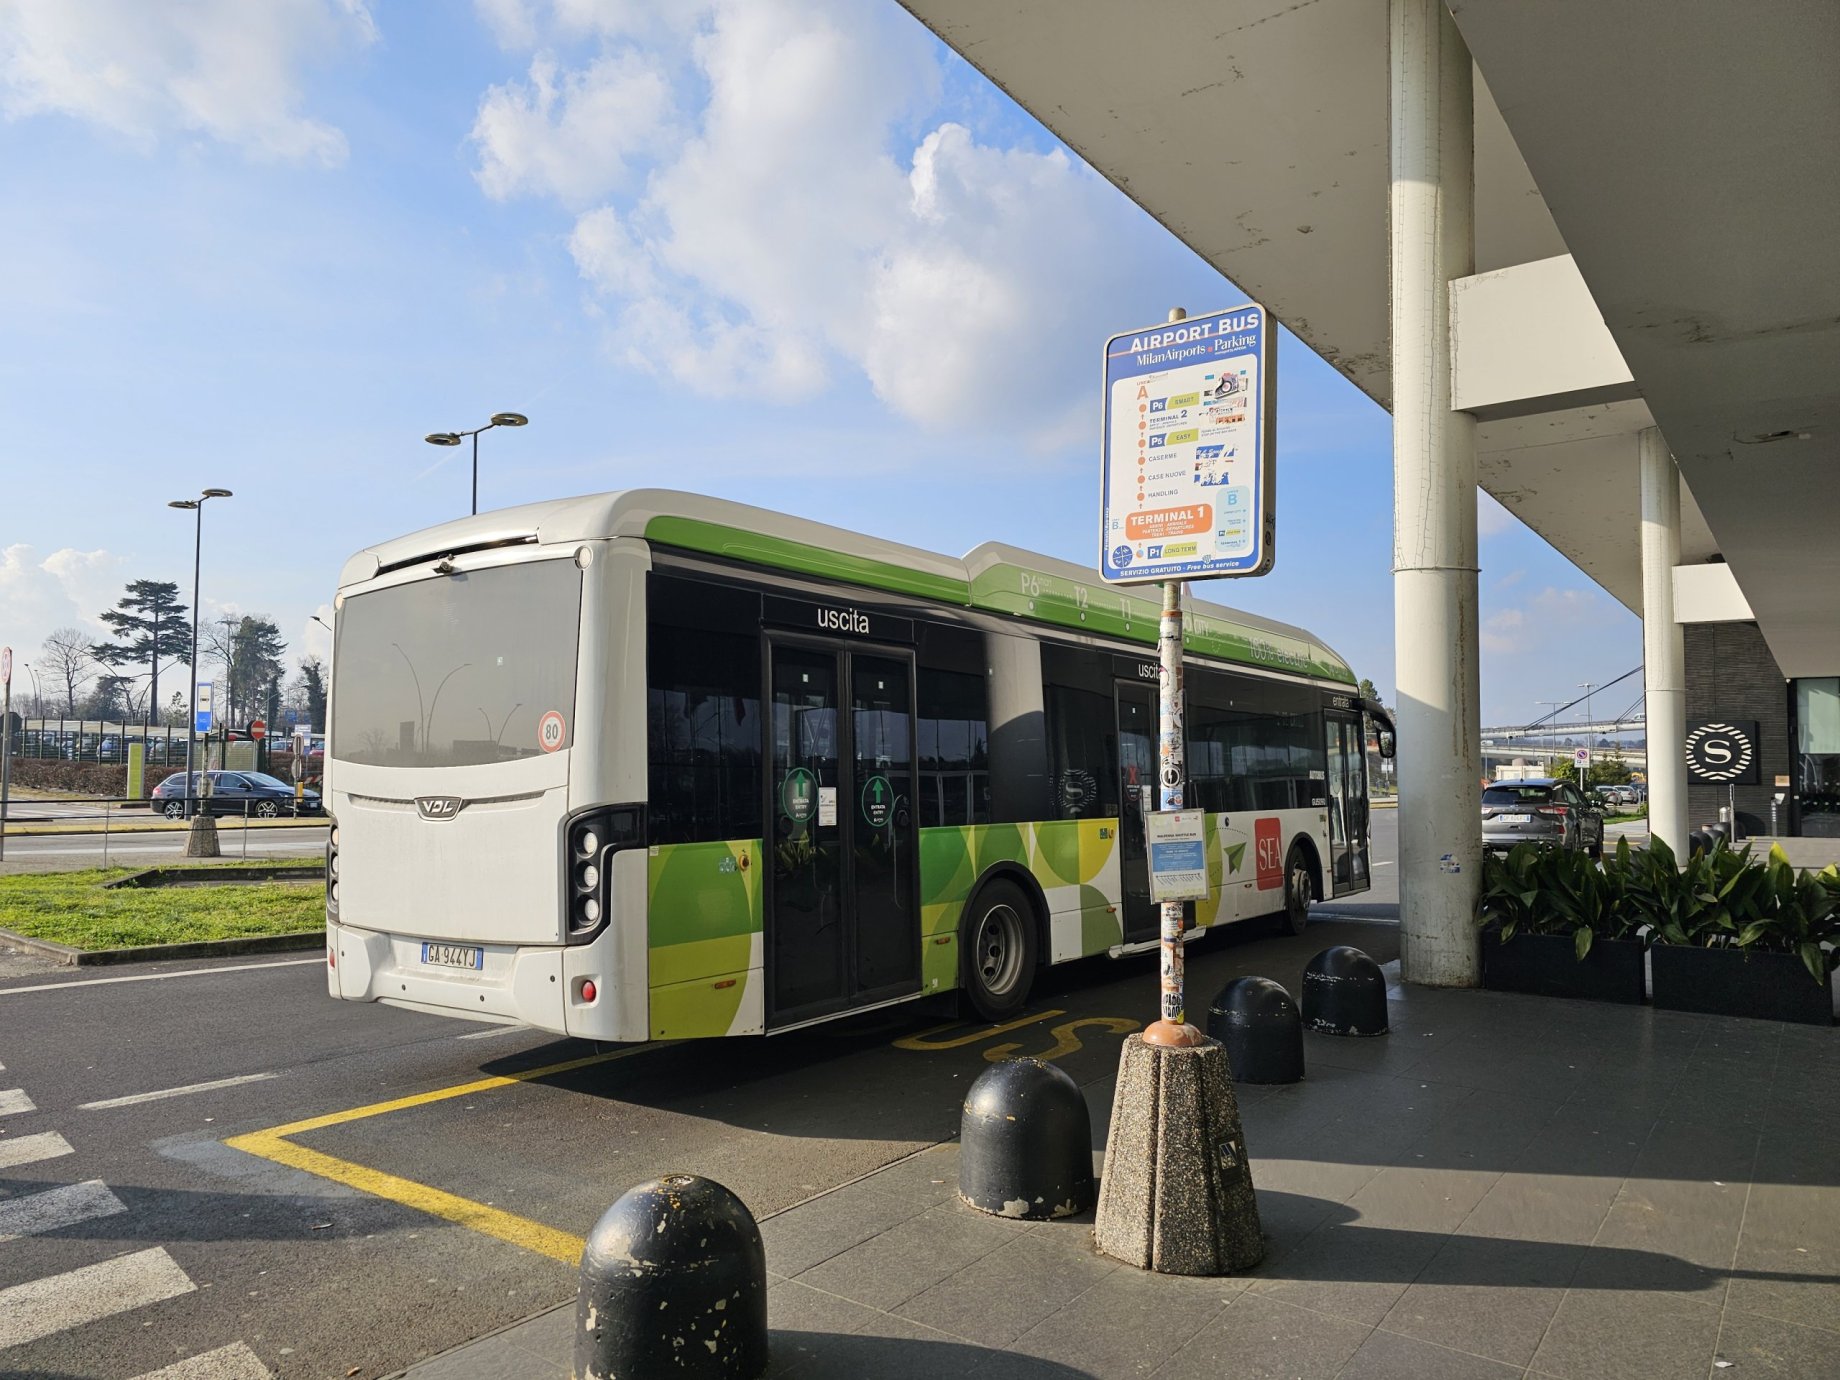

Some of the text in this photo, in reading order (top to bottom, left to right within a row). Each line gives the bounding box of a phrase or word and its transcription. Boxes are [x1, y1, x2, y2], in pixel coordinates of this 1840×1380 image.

[1130, 313, 1259, 353] AIRPORT BUS
[1136, 345, 1206, 366] MilanAirports
[1214, 334, 1257, 351] Parking
[1136, 385, 1149, 400] A
[1152, 401, 1163, 411] P6
[1149, 414, 1179, 424] TERMINAL
[1180, 409, 1188, 418] 2
[1148, 453, 1177, 462] CASERME
[1165, 470, 1187, 478] NUOVE
[1148, 489, 1179, 498] HANDLING
[1228, 494, 1238, 505] B
[1130, 506, 1204, 526] TERMINAL 1
[1112, 521, 1119, 530] B
[1149, 548, 1160, 557] P1
[1164, 546, 1179, 554] LONG
[1150, 565, 1182, 574] GRATUITO
[1215, 560, 1240, 568] service
[1020, 573, 1040, 597] P6
[1073, 586, 1089, 609] T2
[1120, 599, 1131, 619] T1
[817, 607, 870, 634] uscita
[1332, 696, 1350, 708] entrata
[545, 723, 559, 740] 80
[1704, 739, 1732, 764] S
[422, 799, 455, 813] VDL
[1258, 836, 1283, 871] SEA
[428, 945, 477, 967] GA 944YJ
